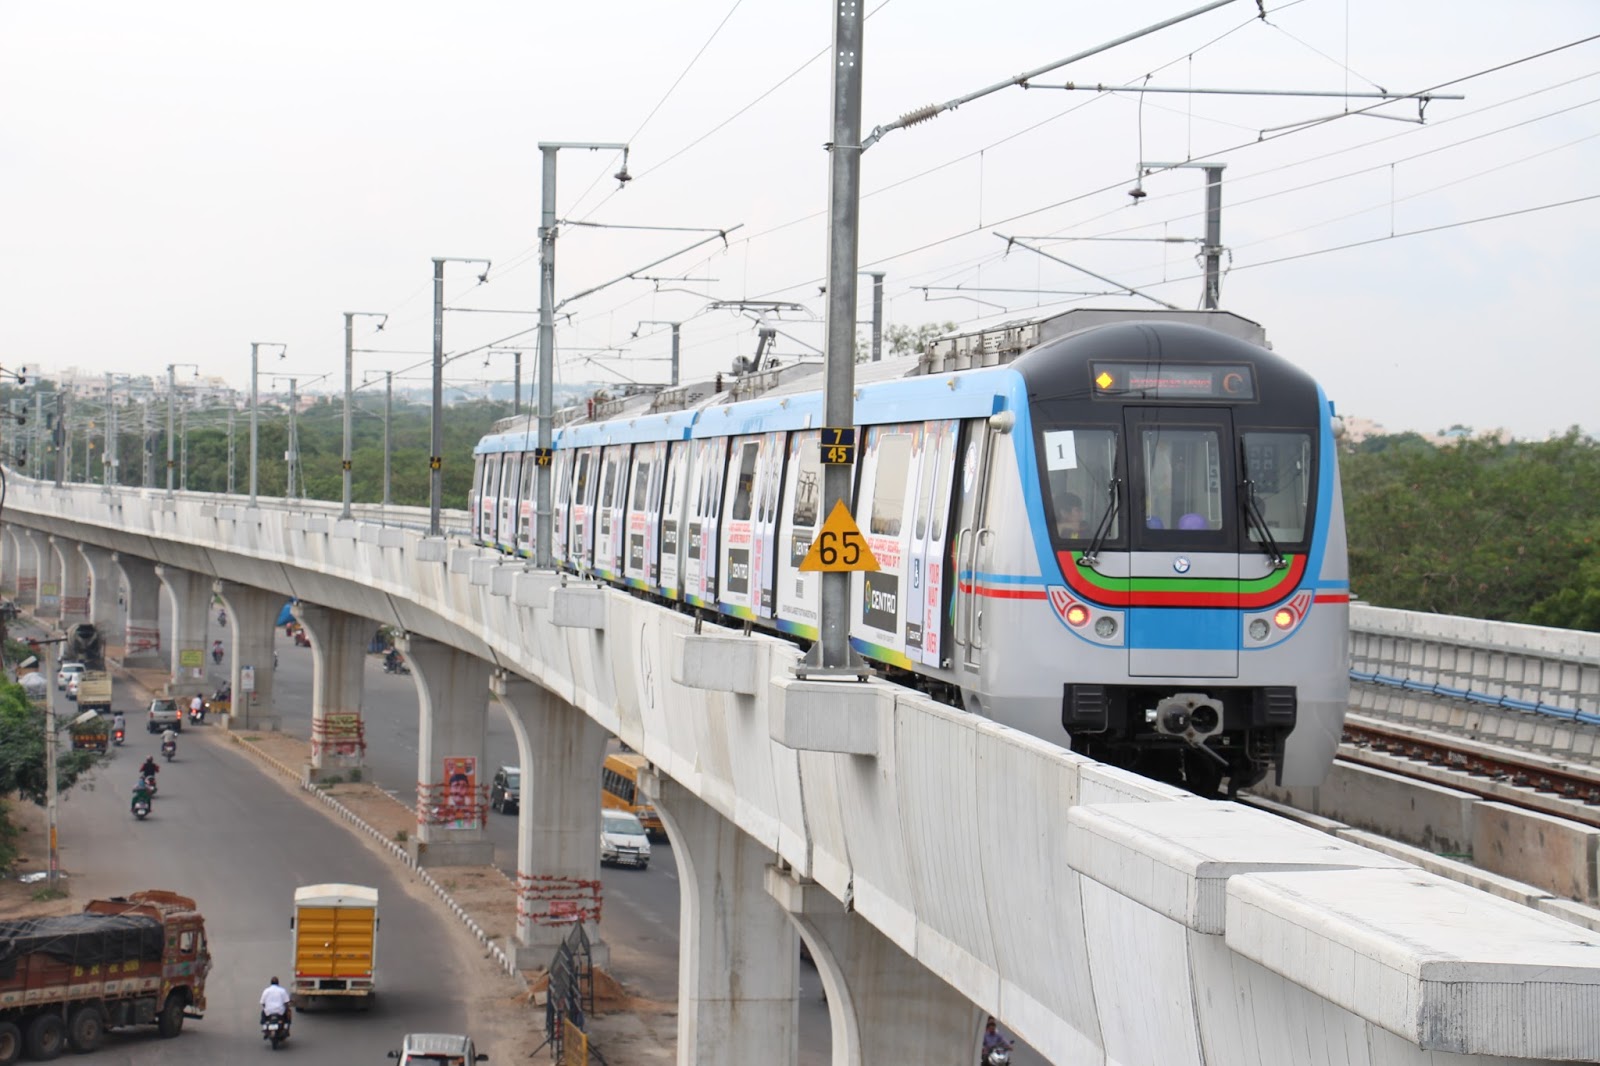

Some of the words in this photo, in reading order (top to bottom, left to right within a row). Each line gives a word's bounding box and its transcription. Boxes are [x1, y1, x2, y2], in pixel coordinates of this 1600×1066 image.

[833, 429, 843, 445] 7
[828, 447, 847, 463] 45
[1056, 443, 1064, 460] 1
[820, 531, 860, 566] 65
[928, 563, 940, 584] YOUR
[871, 589, 896, 614] CENTRO
